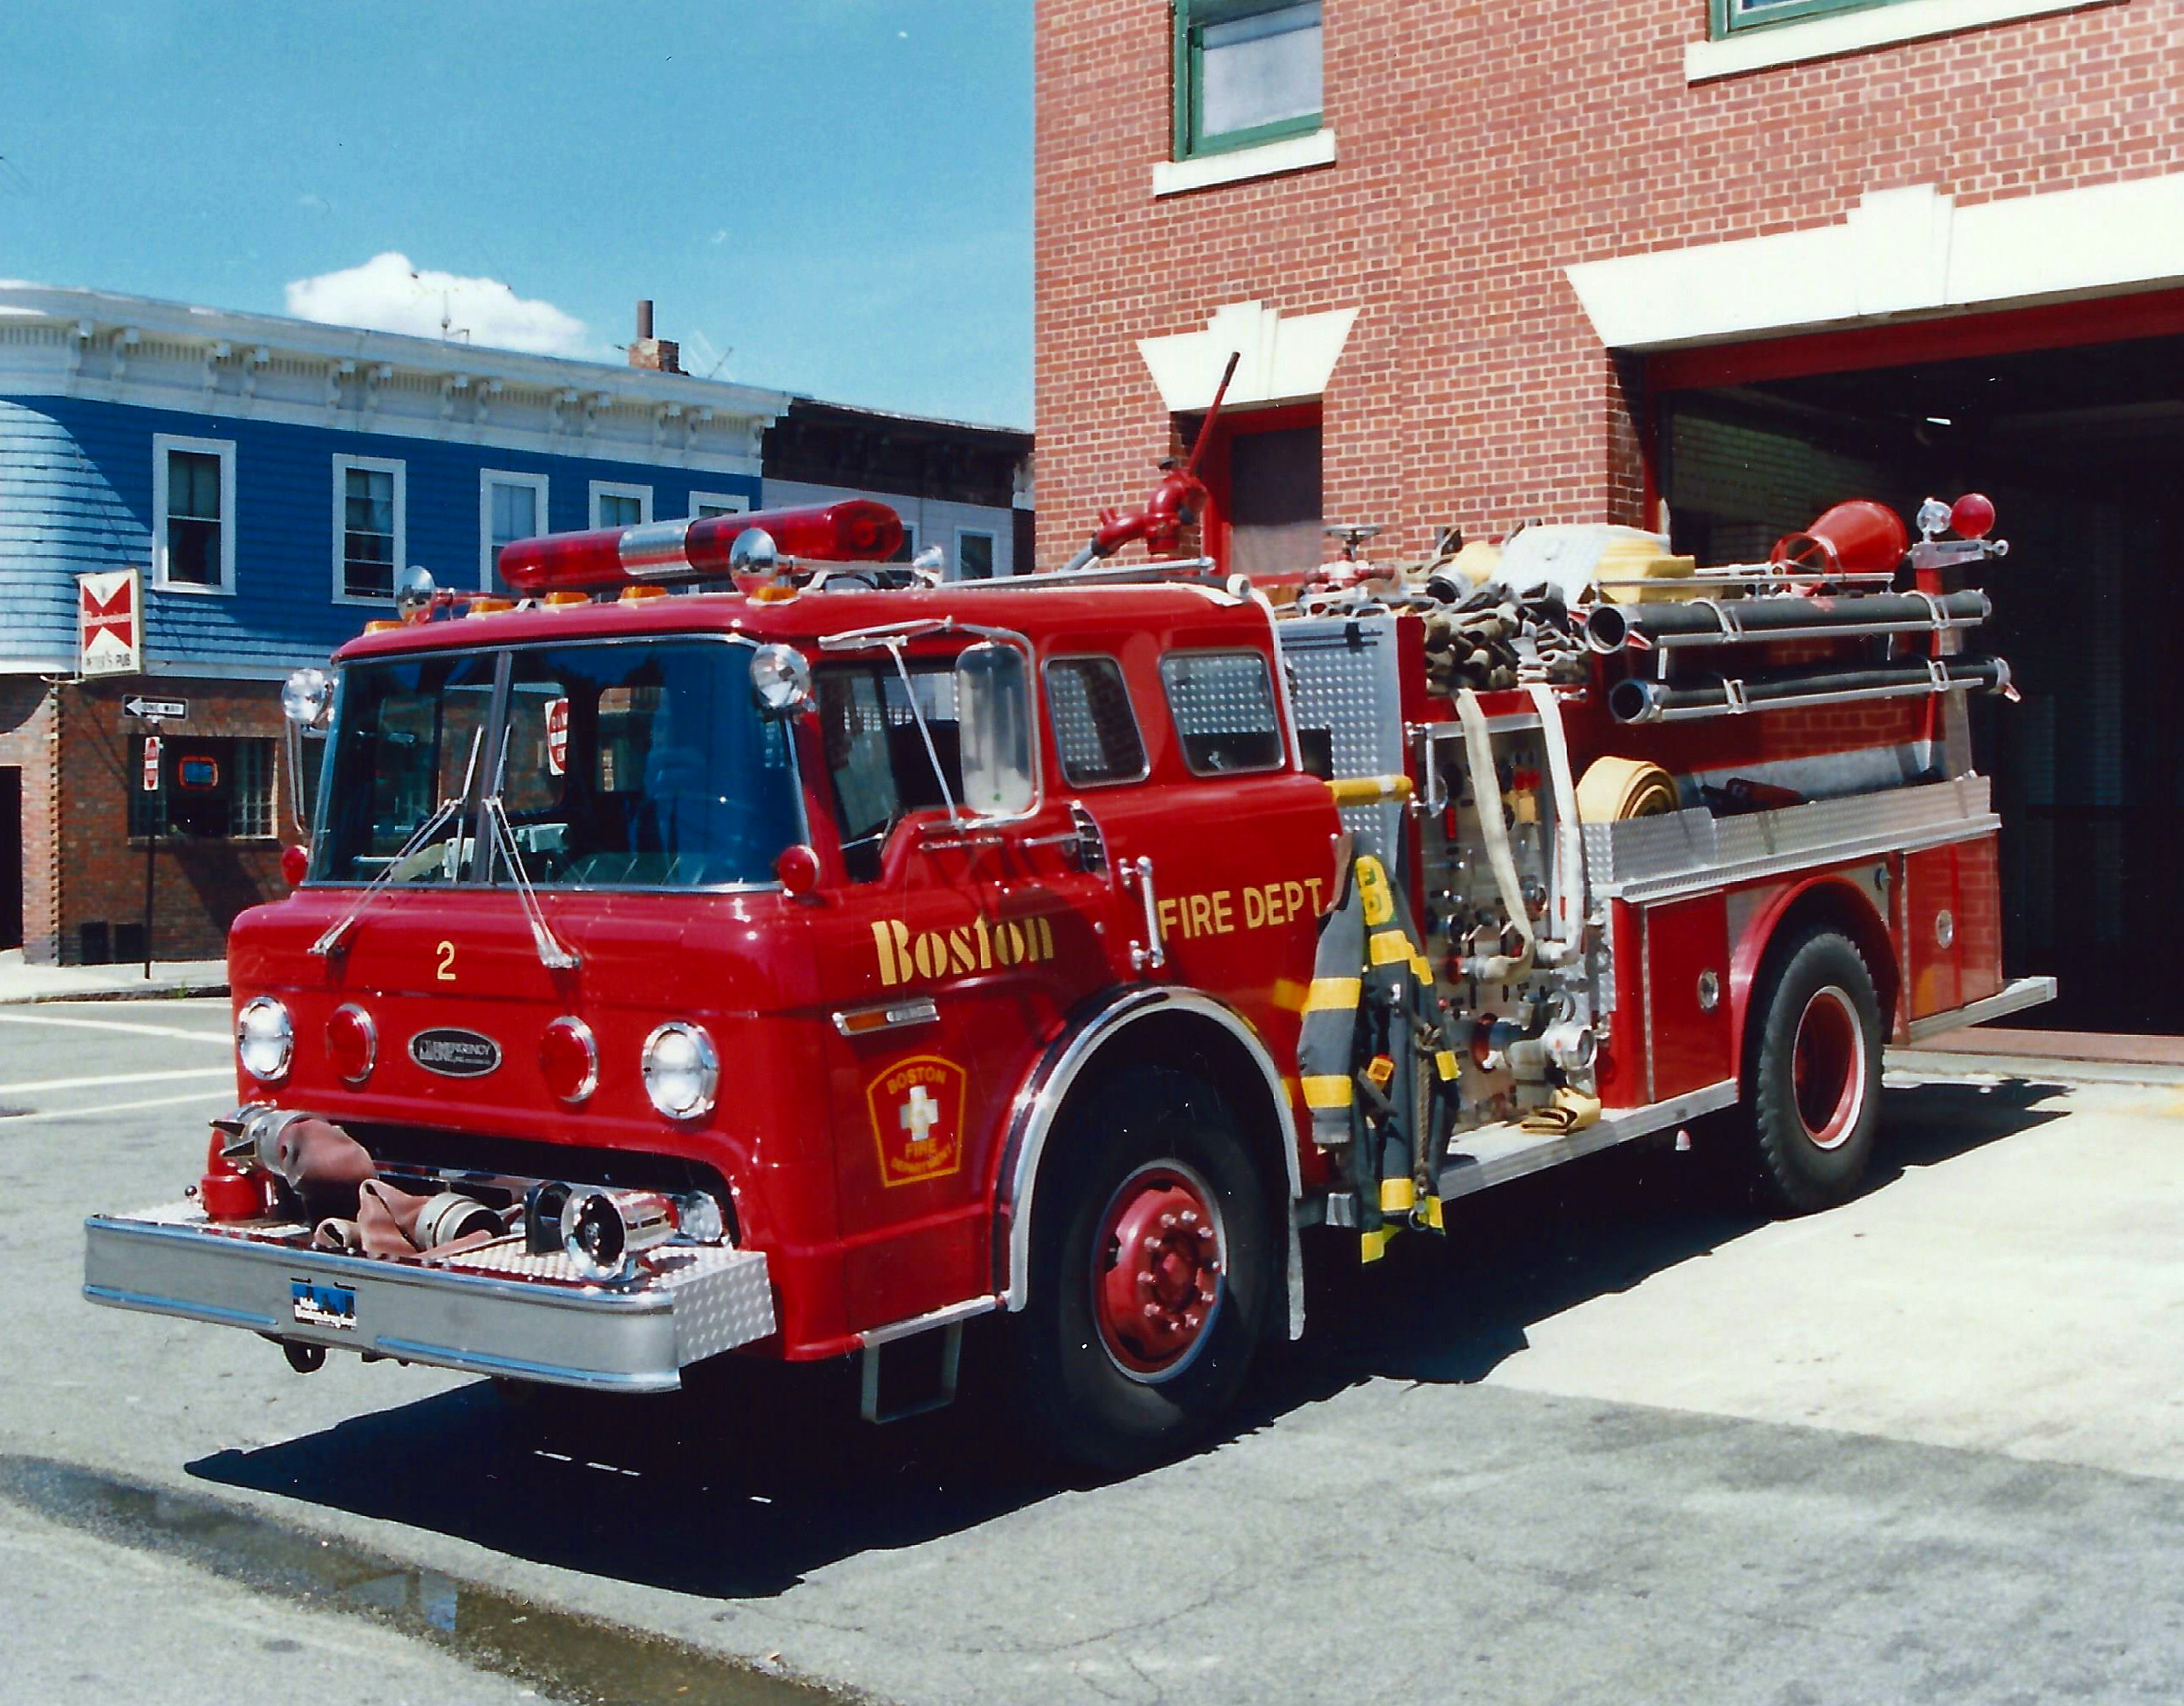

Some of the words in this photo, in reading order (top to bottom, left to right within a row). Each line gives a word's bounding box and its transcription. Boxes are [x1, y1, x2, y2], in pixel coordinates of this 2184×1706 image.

[1157, 890, 1235, 942] FIRE
[1242, 878, 1322, 930] DEPT
[436, 940, 456, 981] 2
[870, 914, 1054, 986] Boston
[886, 1065, 947, 1095] BOSTON
[905, 1138, 937, 1159] FIRE
